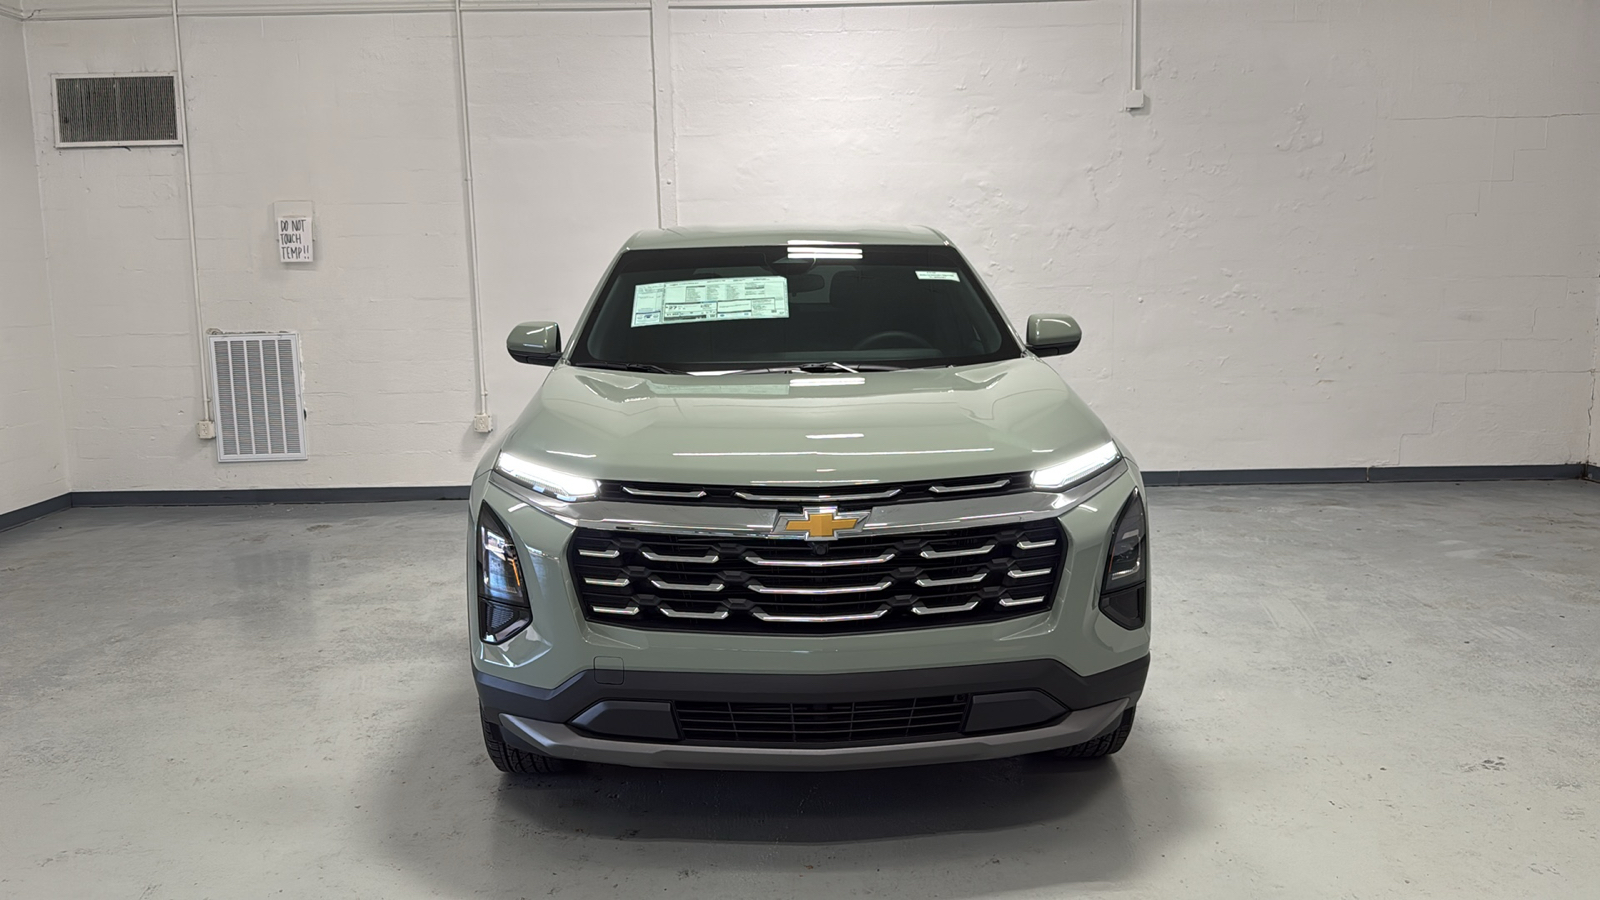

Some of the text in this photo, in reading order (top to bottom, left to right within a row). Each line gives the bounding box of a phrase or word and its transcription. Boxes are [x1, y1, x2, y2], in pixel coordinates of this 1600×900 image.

[280, 219, 306, 232] DO NOT
[280, 233, 302, 245] TOUCH
[281, 245, 310, 260] TEMP!!
